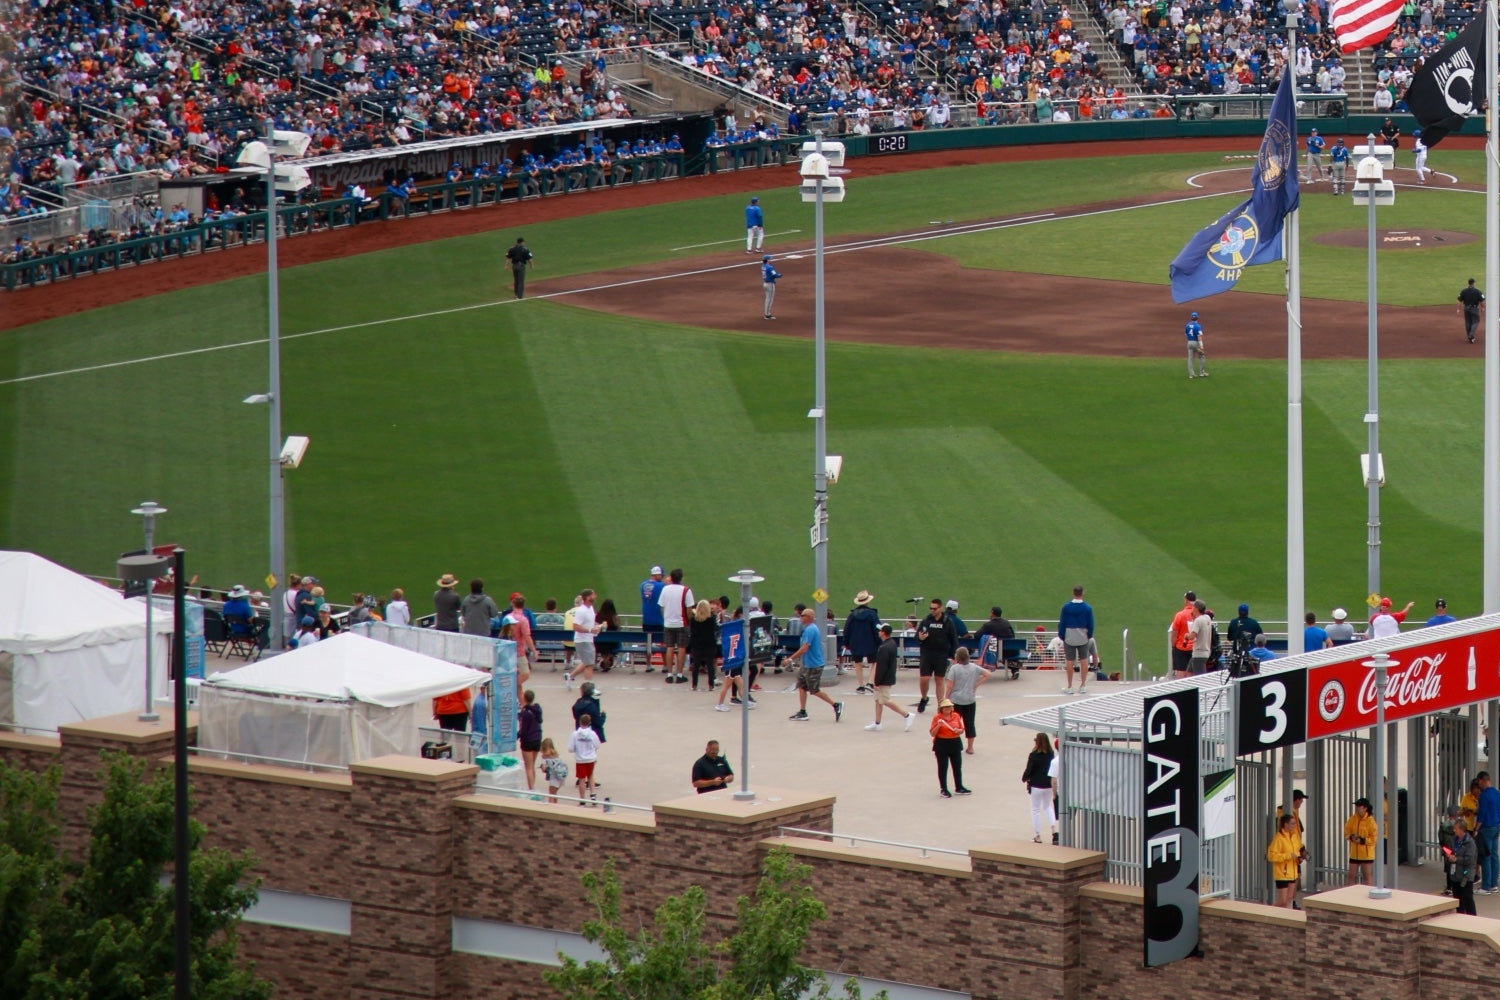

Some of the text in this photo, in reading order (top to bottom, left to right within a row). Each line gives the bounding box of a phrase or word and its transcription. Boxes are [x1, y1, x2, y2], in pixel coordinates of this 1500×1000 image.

[407, 151, 449, 175] SHOW
[879, 136, 905, 151] 0:20
[728, 633, 740, 660] F
[1357, 652, 1447, 715] Coa-Cola
[1258, 680, 1288, 744] 3
[1147, 699, 1181, 869] GATE
